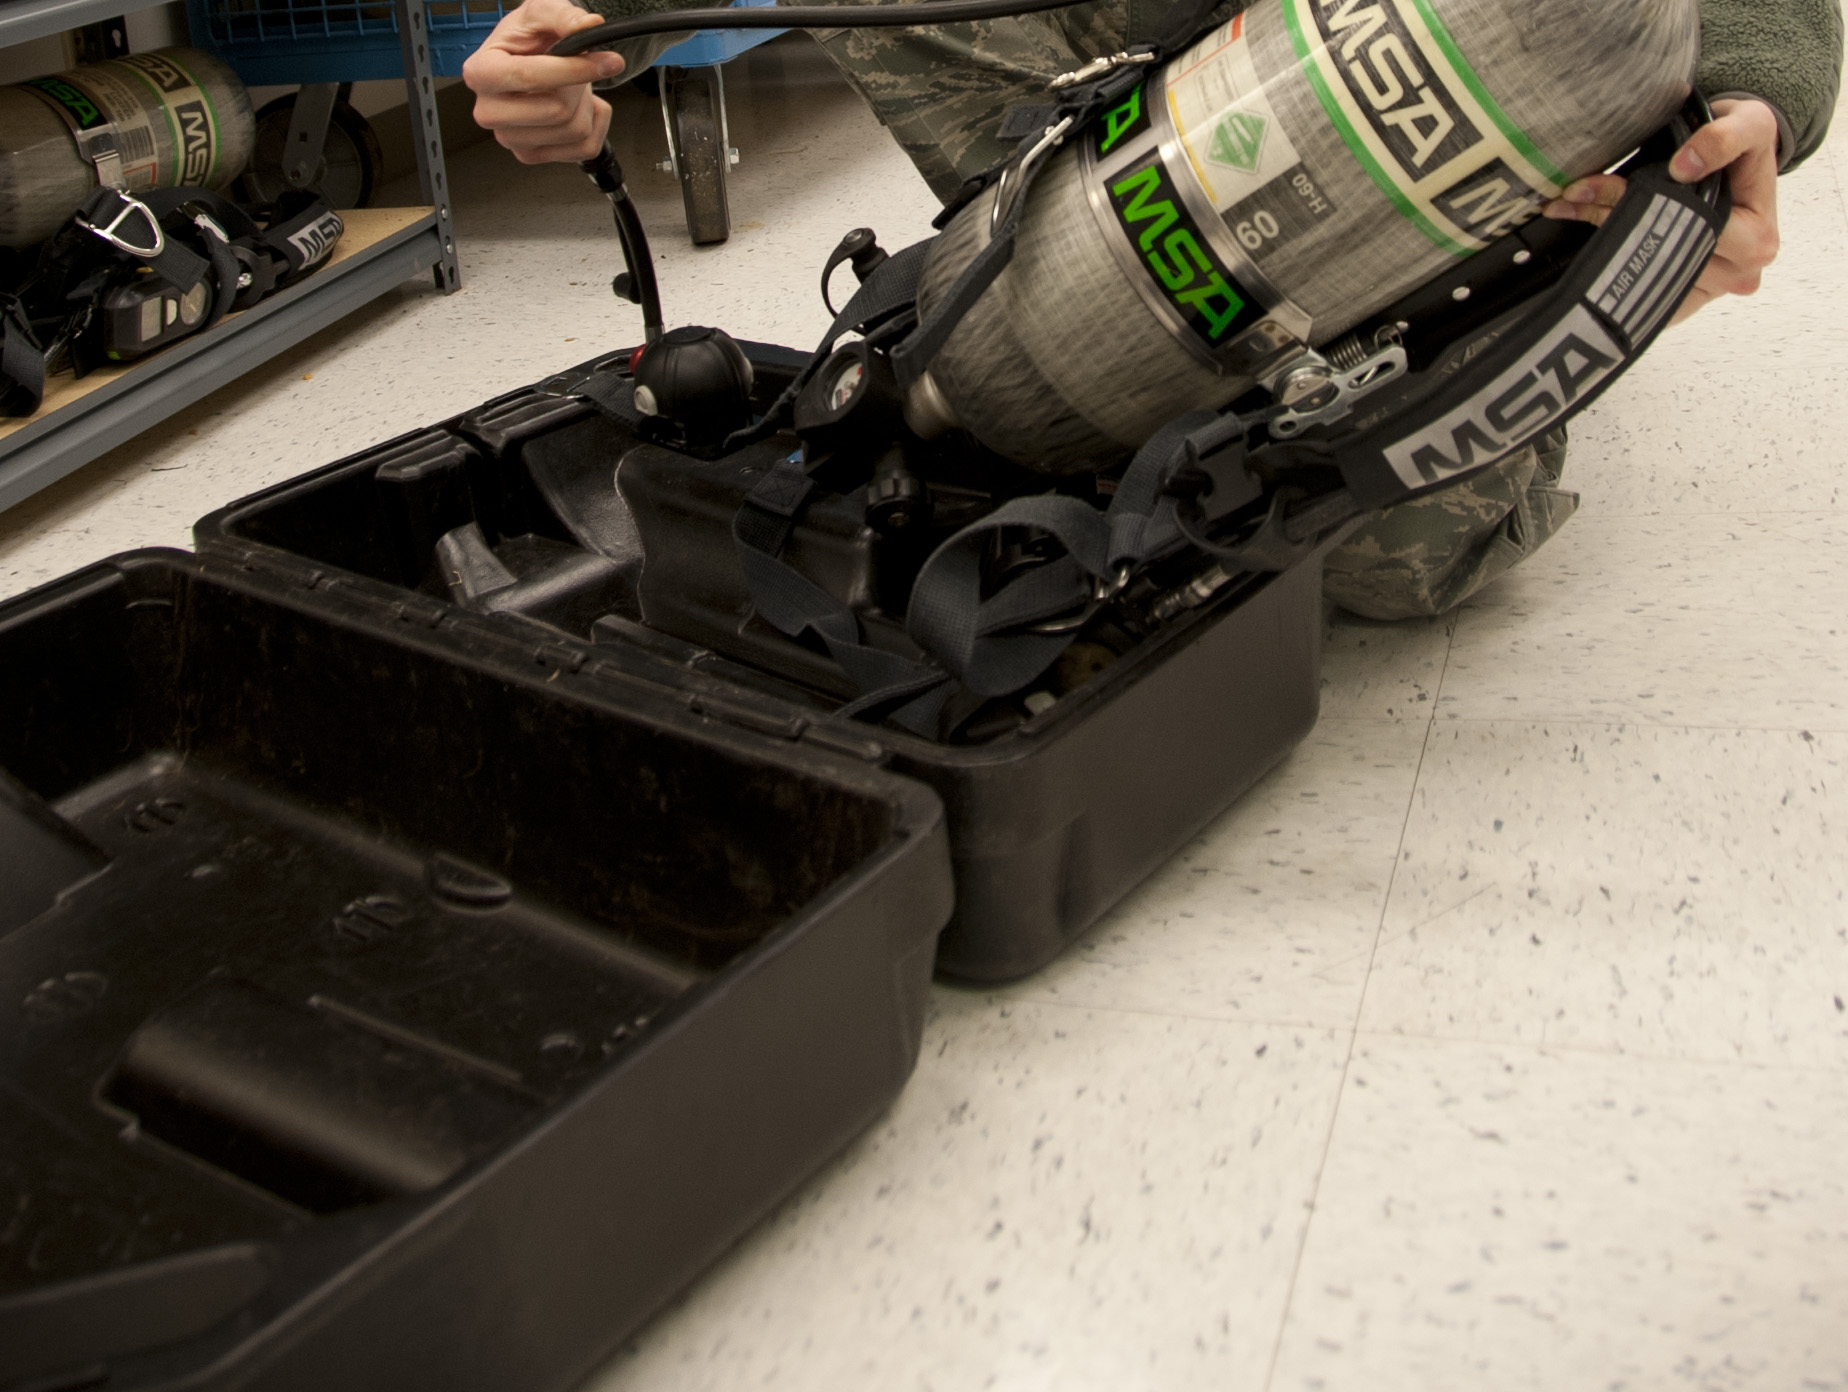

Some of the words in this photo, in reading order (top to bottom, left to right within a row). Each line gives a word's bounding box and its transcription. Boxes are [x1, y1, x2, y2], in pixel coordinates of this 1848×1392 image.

[1112, 164, 1245, 340] MSA
[1236, 210, 1280, 250] 60
[1612, 271, 1634, 300] AIR
[1629, 234, 1661, 276] MASK
[1410, 332, 1620, 486] MSA
